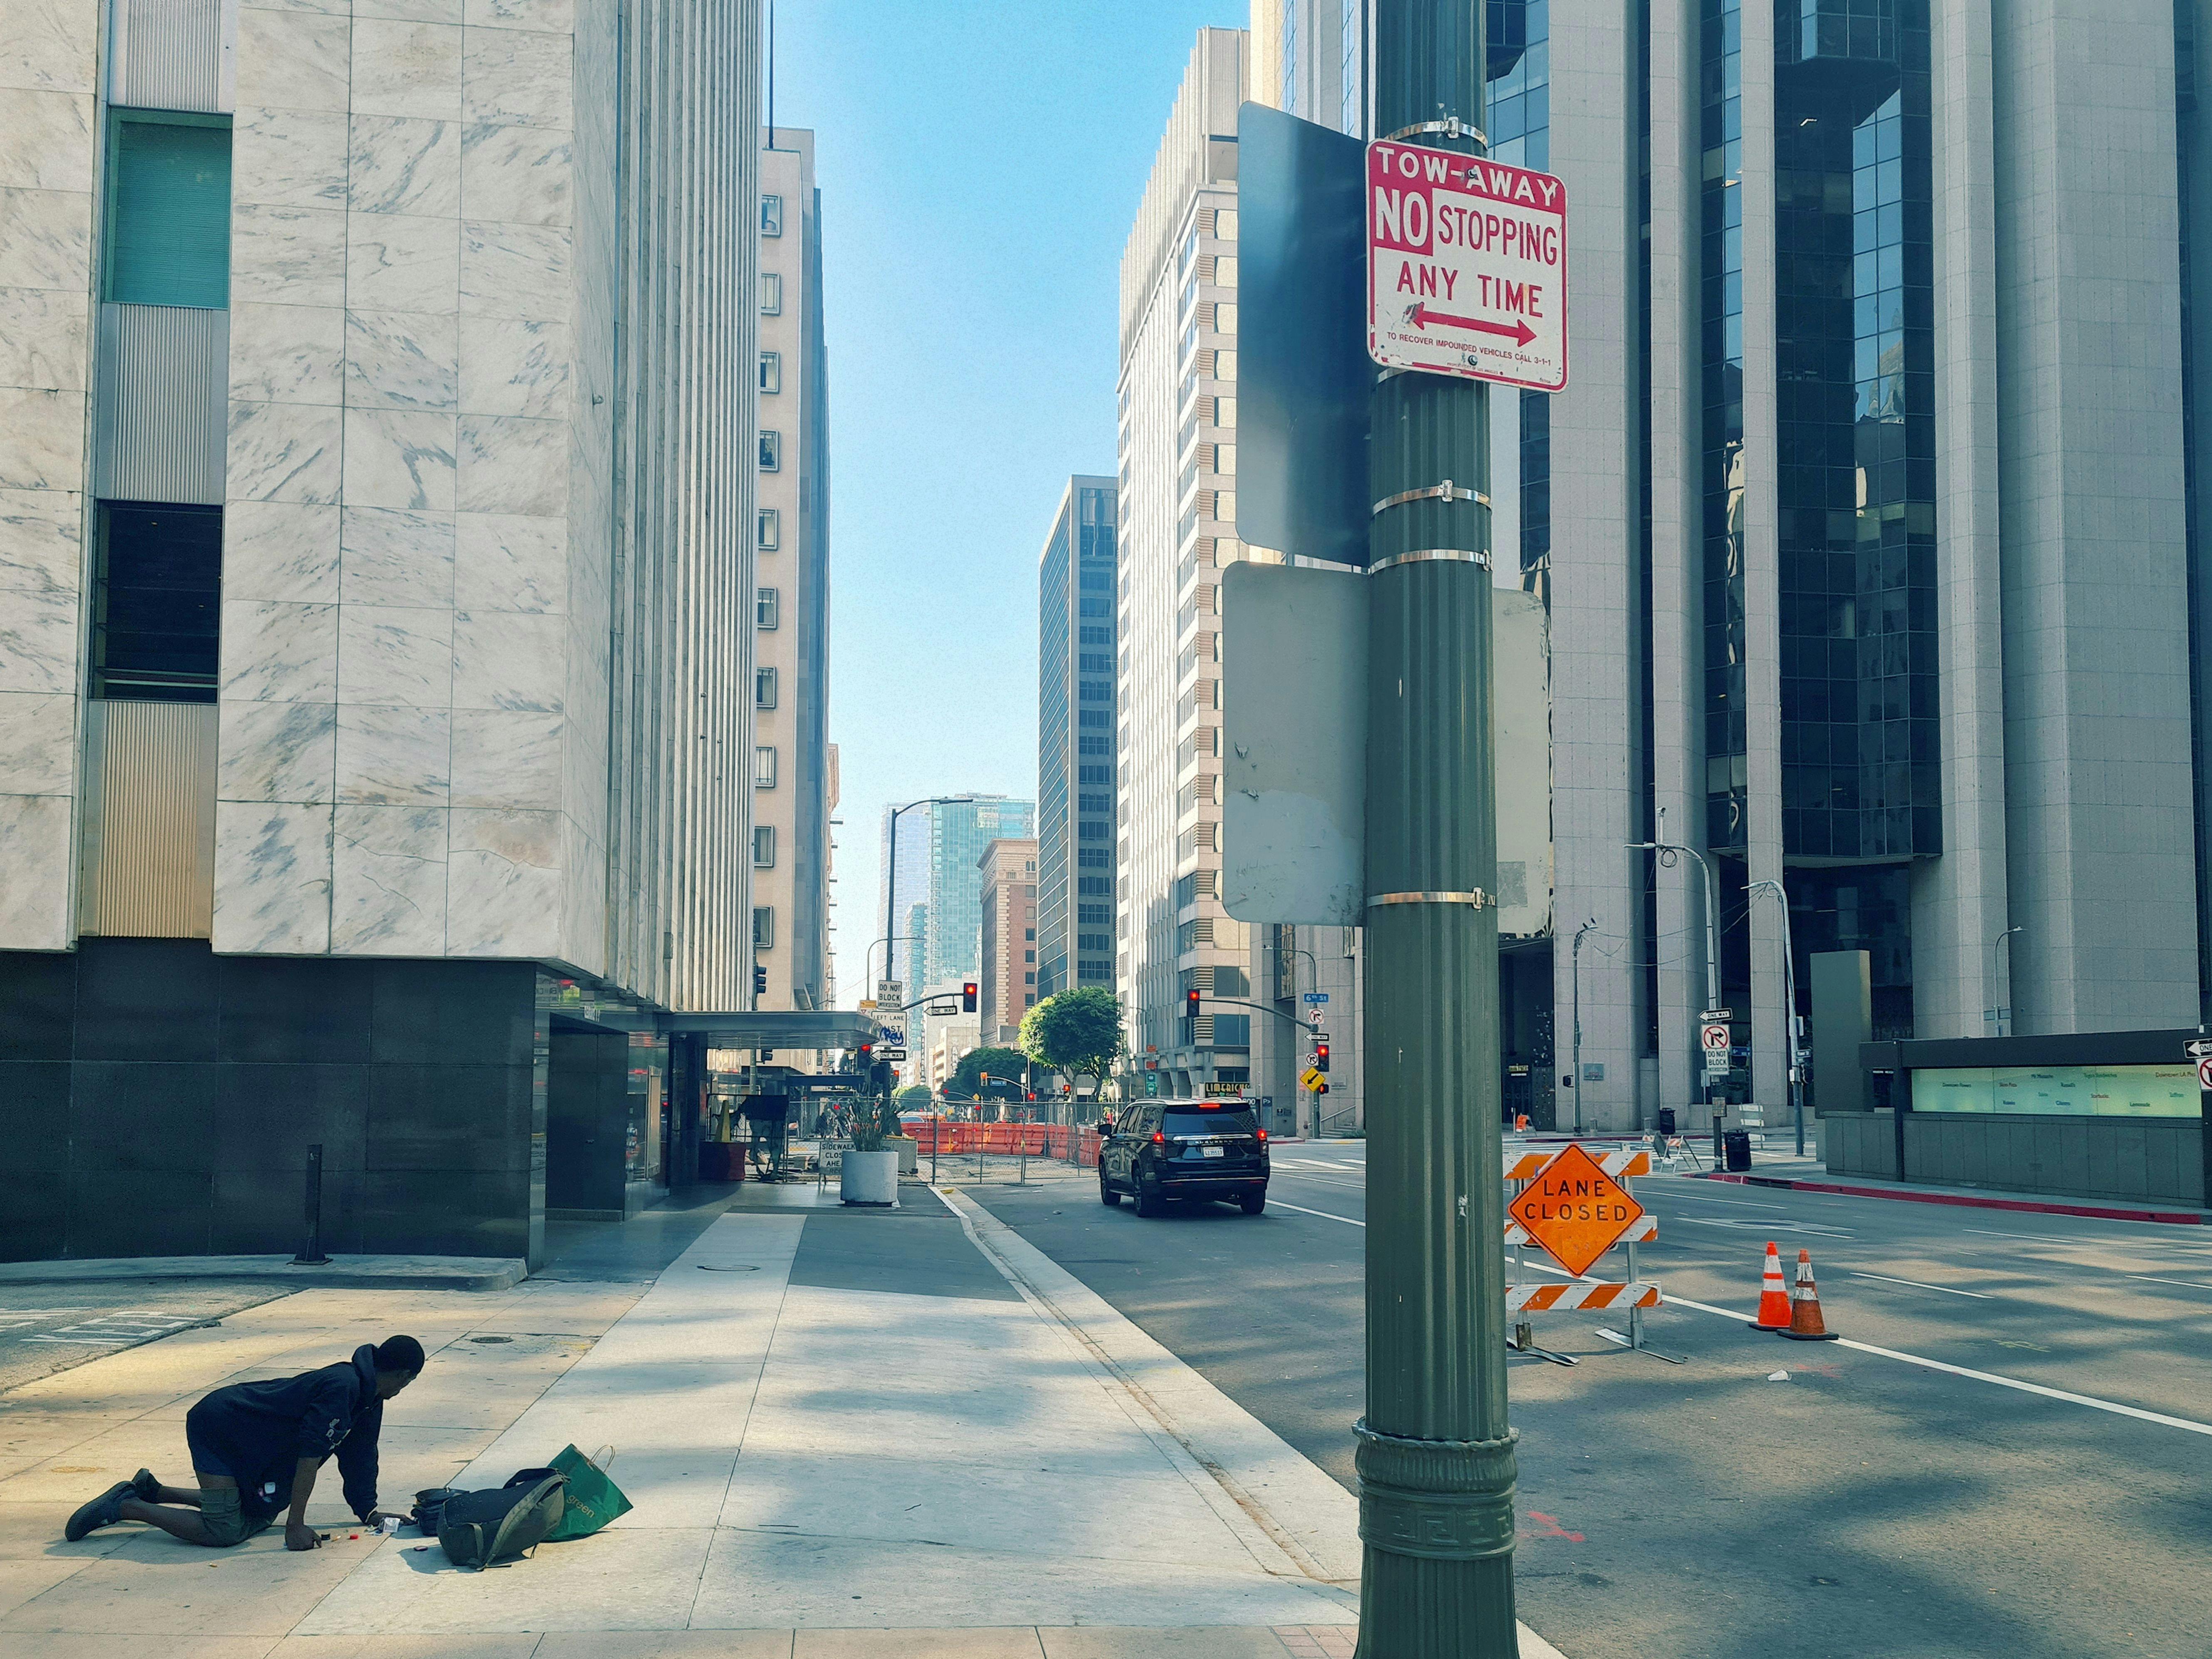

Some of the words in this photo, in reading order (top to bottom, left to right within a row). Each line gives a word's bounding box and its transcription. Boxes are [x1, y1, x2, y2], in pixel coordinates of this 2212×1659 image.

[1376, 146, 1559, 207] TOW-AWAY
[1375, 186, 1429, 247] NO
[1438, 205, 1557, 266] STOPPING
[1397, 261, 1459, 301] ANY
[1477, 274, 1543, 318] TIME
[1399, 334, 1433, 345] RECOVER
[1436, 340, 1477, 353] IMPOUNDED
[1480, 347, 1512, 359] VEHICLES
[1515, 354, 1532, 363] CALL
[1534, 357, 1551, 366] 3-1-1
[1544, 1180, 1605, 1197] LANE
[1524, 1203, 1627, 1221] CLOSED
[566, 1495, 594, 1518] green
